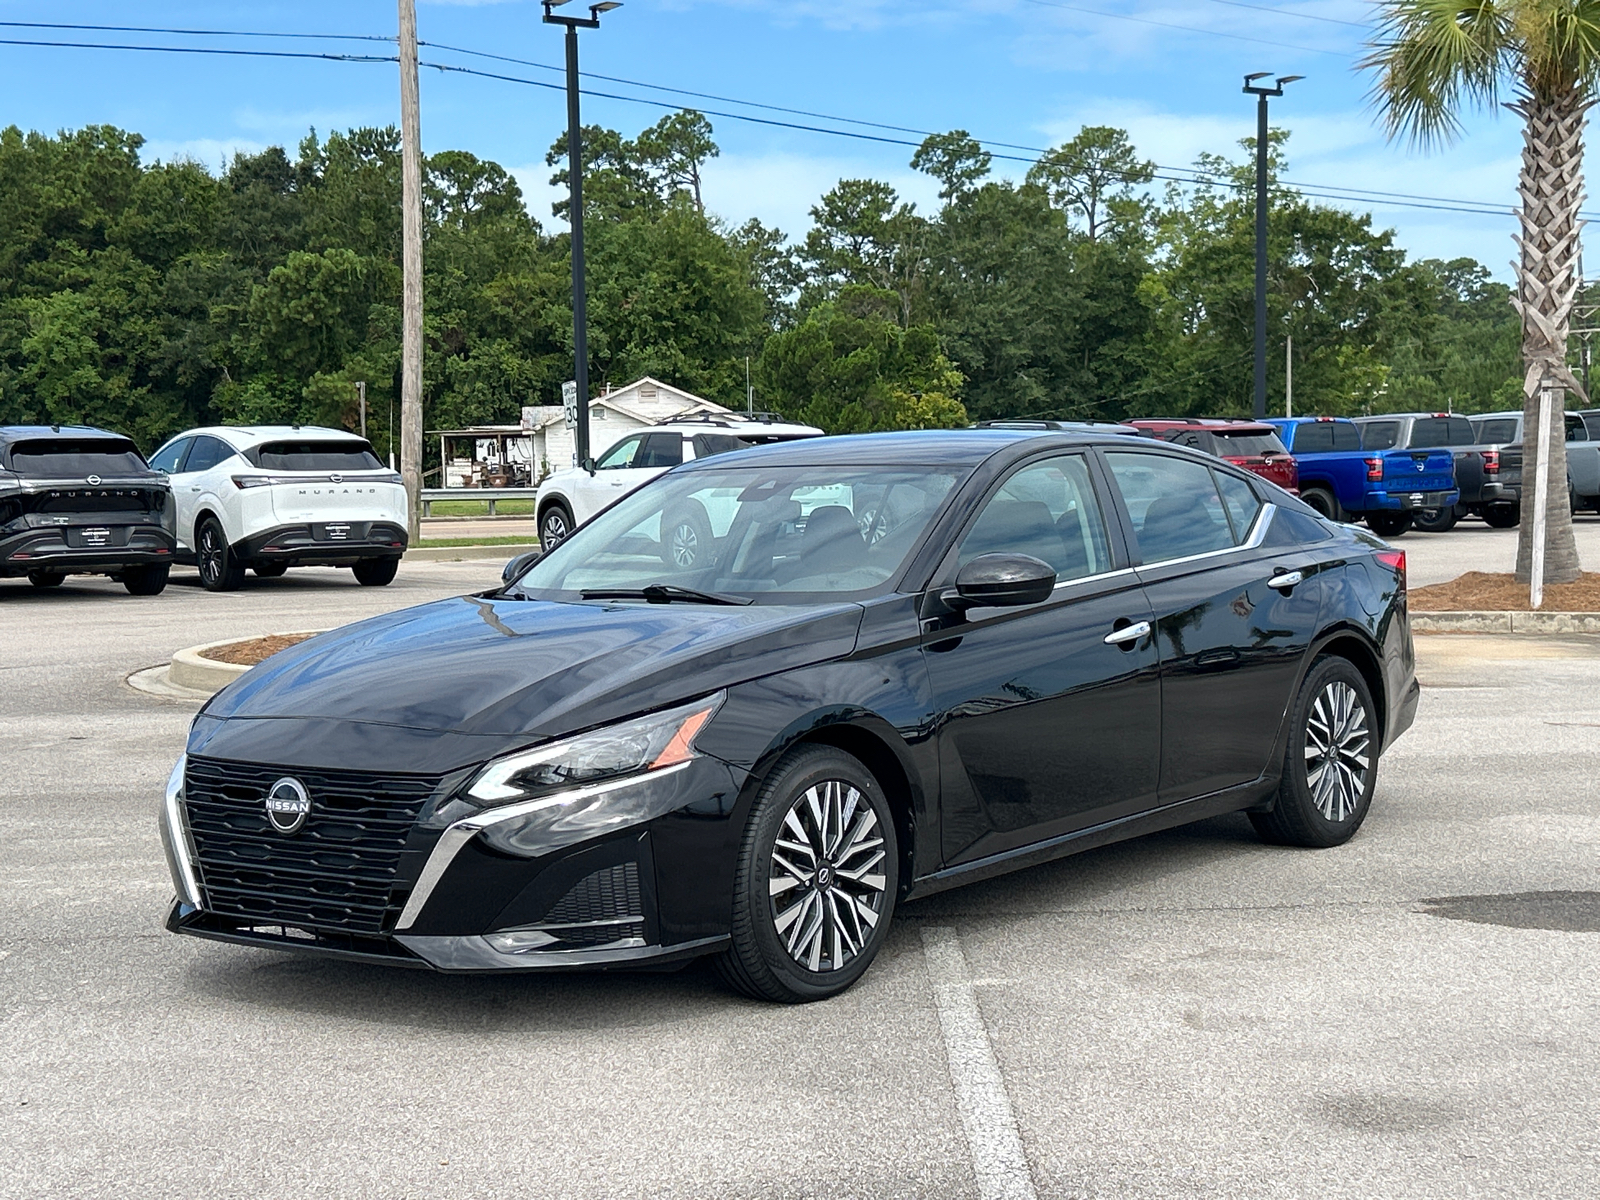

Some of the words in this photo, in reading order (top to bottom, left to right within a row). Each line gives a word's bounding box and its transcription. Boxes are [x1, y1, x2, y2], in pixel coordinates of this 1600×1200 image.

[566, 405, 578, 423] 30
[51, 490, 138, 498] MURANO
[265, 799, 309, 812] NISSAN
